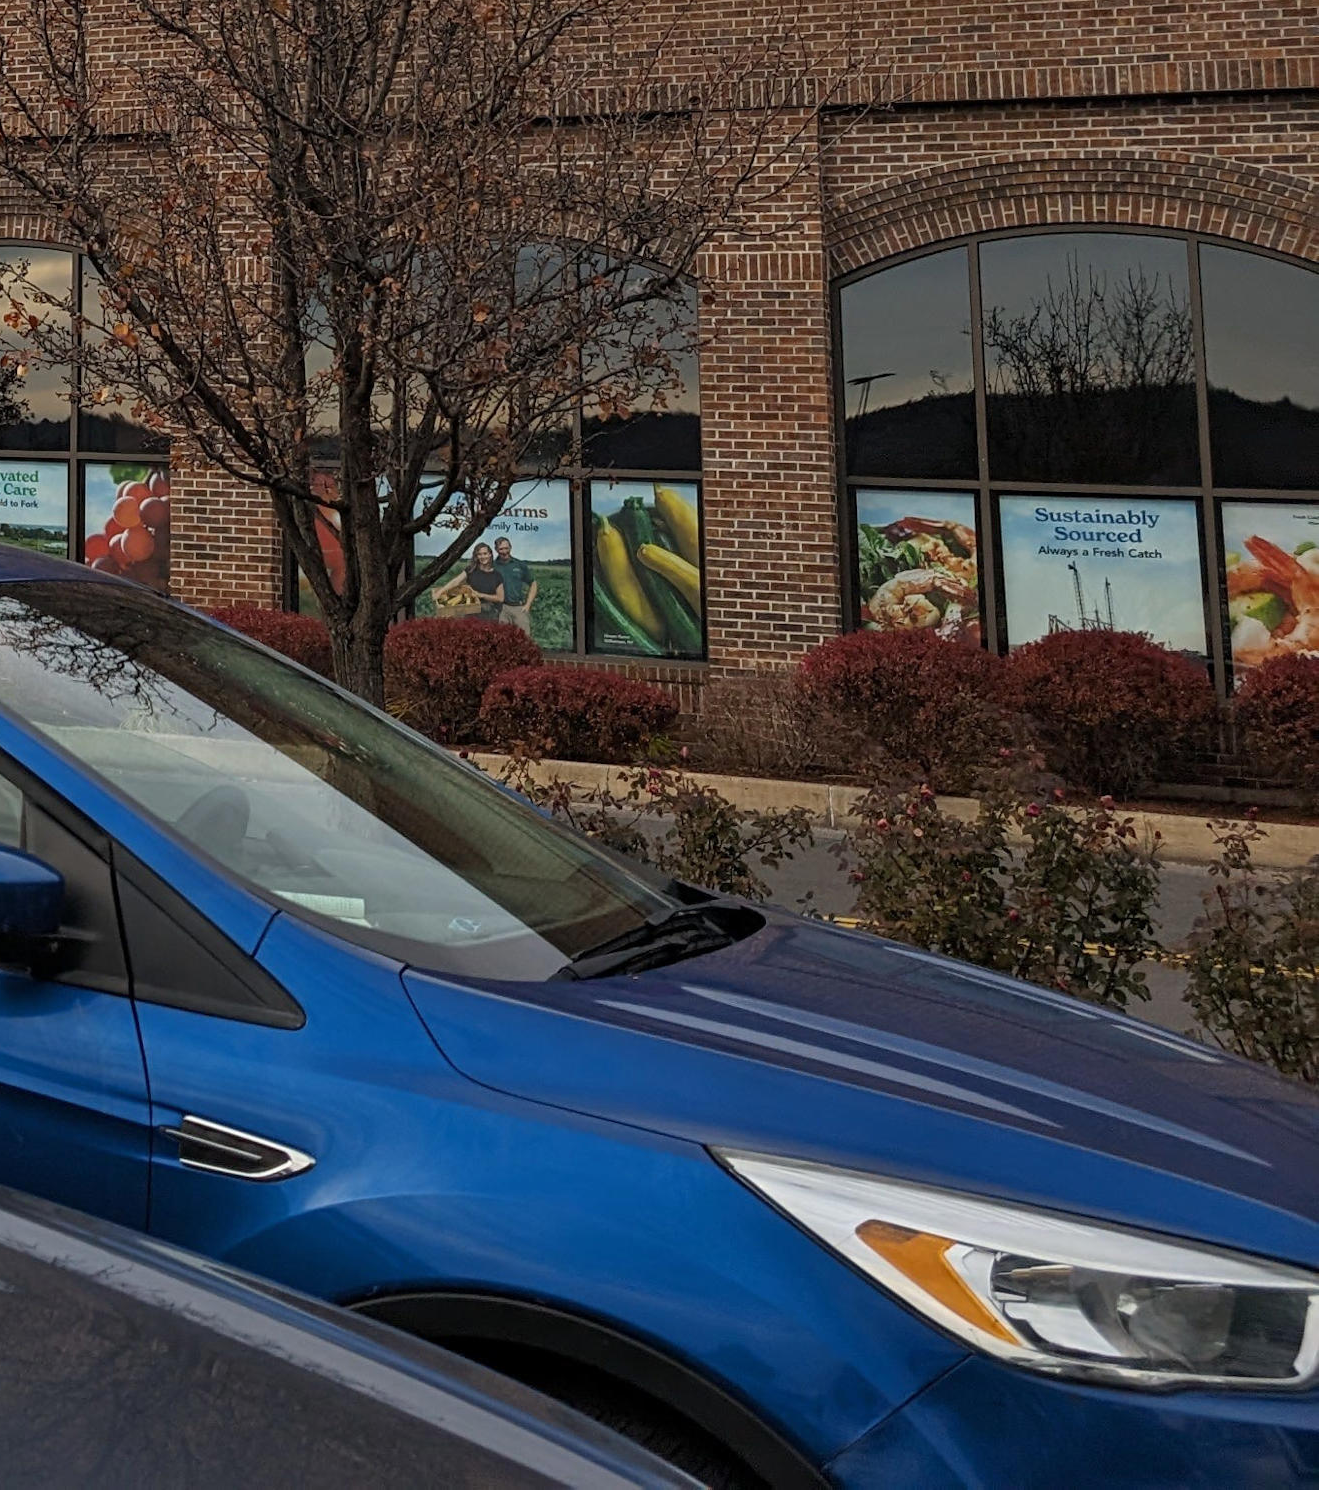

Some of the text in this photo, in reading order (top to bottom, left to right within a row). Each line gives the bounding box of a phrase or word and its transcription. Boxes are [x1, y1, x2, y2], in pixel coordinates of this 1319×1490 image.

[4, 483, 37, 496] Care
[21, 500, 39, 508] Fork
[499, 506, 548, 519] arms
[1035, 507, 1160, 528] Sustainably
[515, 522, 539, 532] Table
[1054, 526, 1143, 543] Sourced
[1038, 546, 1162, 559] Always a Fresh Catch
